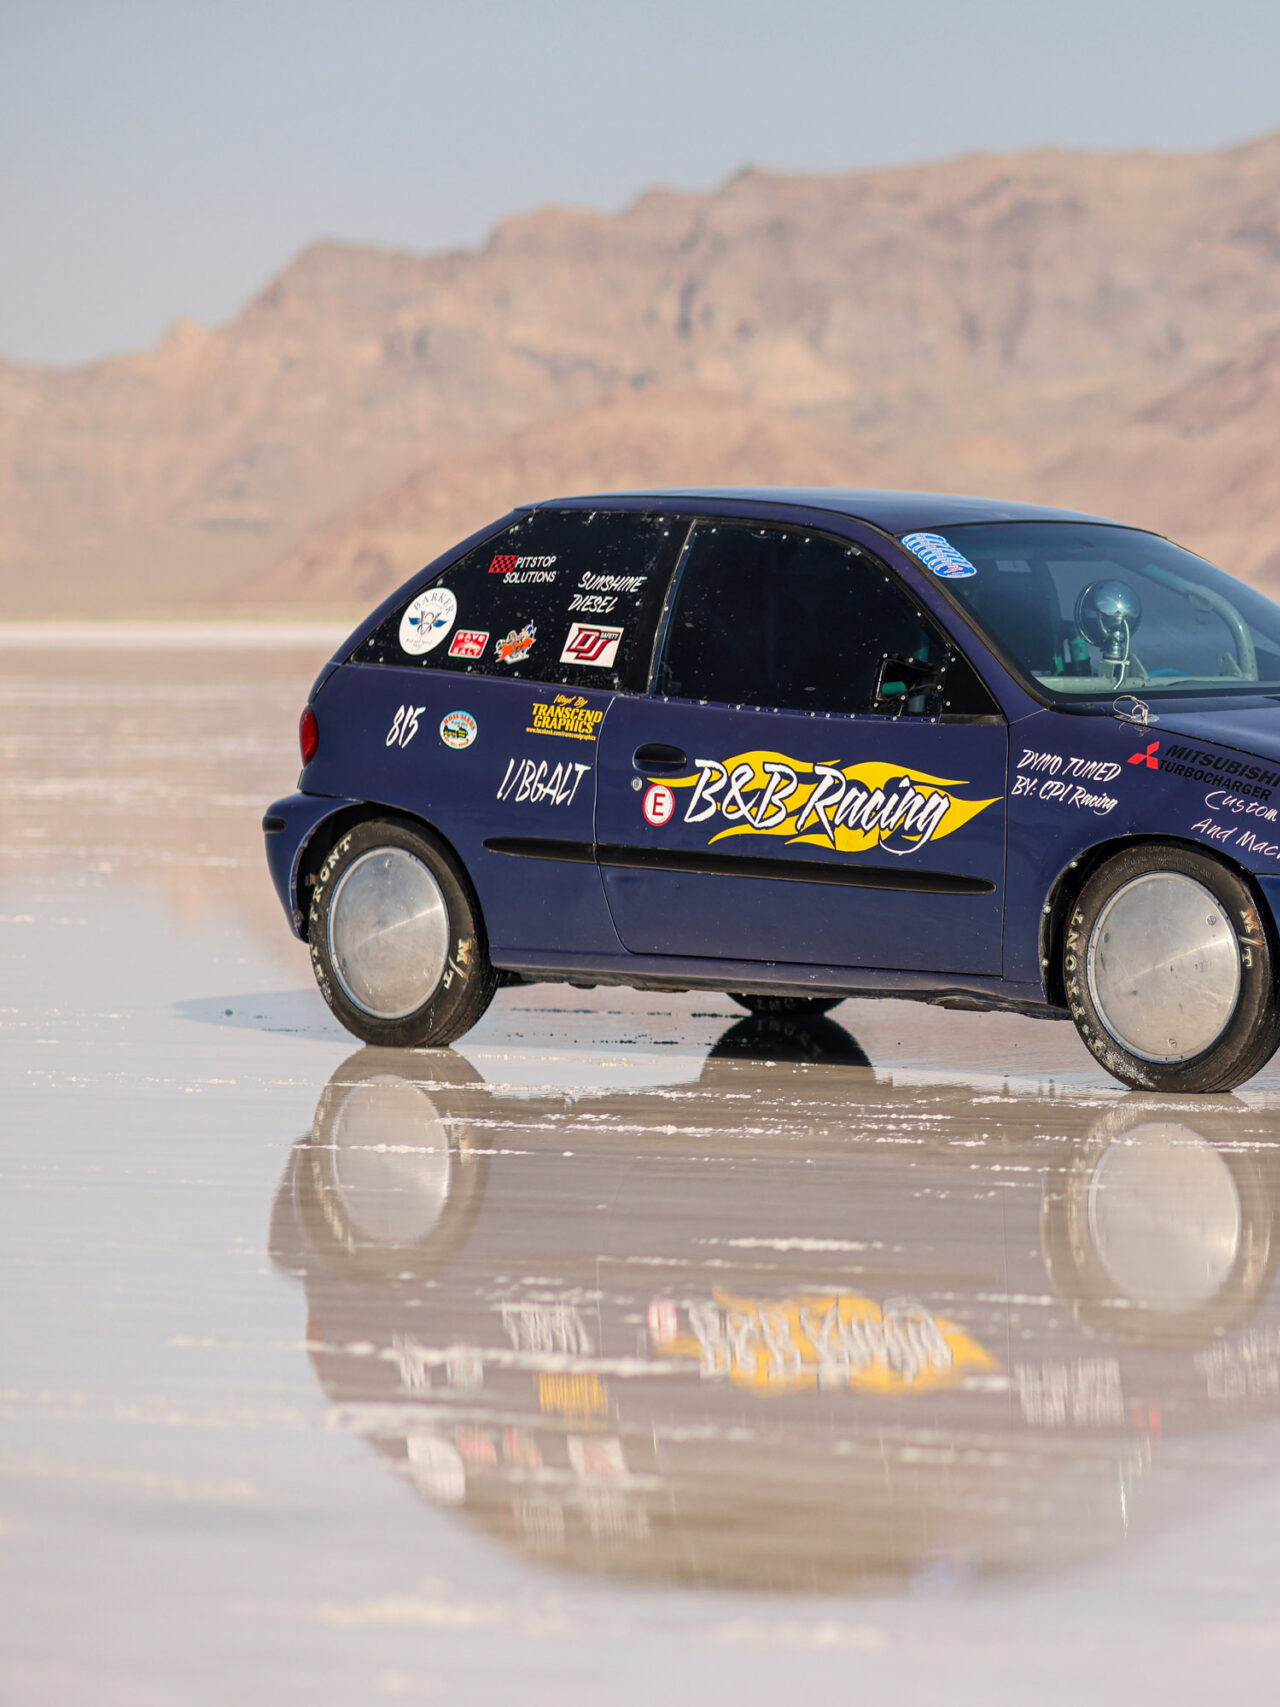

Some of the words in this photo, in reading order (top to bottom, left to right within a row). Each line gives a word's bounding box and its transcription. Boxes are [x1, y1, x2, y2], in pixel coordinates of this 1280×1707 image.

[515, 556, 557, 568] PITSTOP
[503, 571, 557, 583] SOLUTIONS
[578, 571, 648, 592] SUNSHINE
[568, 594, 618, 613] DIESEL
[457, 634, 486, 643] SAVE
[600, 632, 619, 640] SAFETY
[453, 647, 480, 656] SALT
[574, 696, 588, 708] By
[532, 703, 603, 723] TRANSCEND
[386, 704, 426, 749] 815
[533, 715, 594, 734] GRAPHICS
[1016, 749, 1062, 775] DYNO
[1062, 757, 1121, 782] TUNED
[1159, 759, 1272, 801] TURBOCHARGER
[652, 792, 666, 816] E
[1011, 775, 1038, 796] BY:
[1068, 786, 1118, 815] Racing
[684, 758, 798, 829] B&B
[797, 764, 950, 856] Racing
[1205, 790, 1278, 822] Custom
[1191, 817, 1238, 843] And
